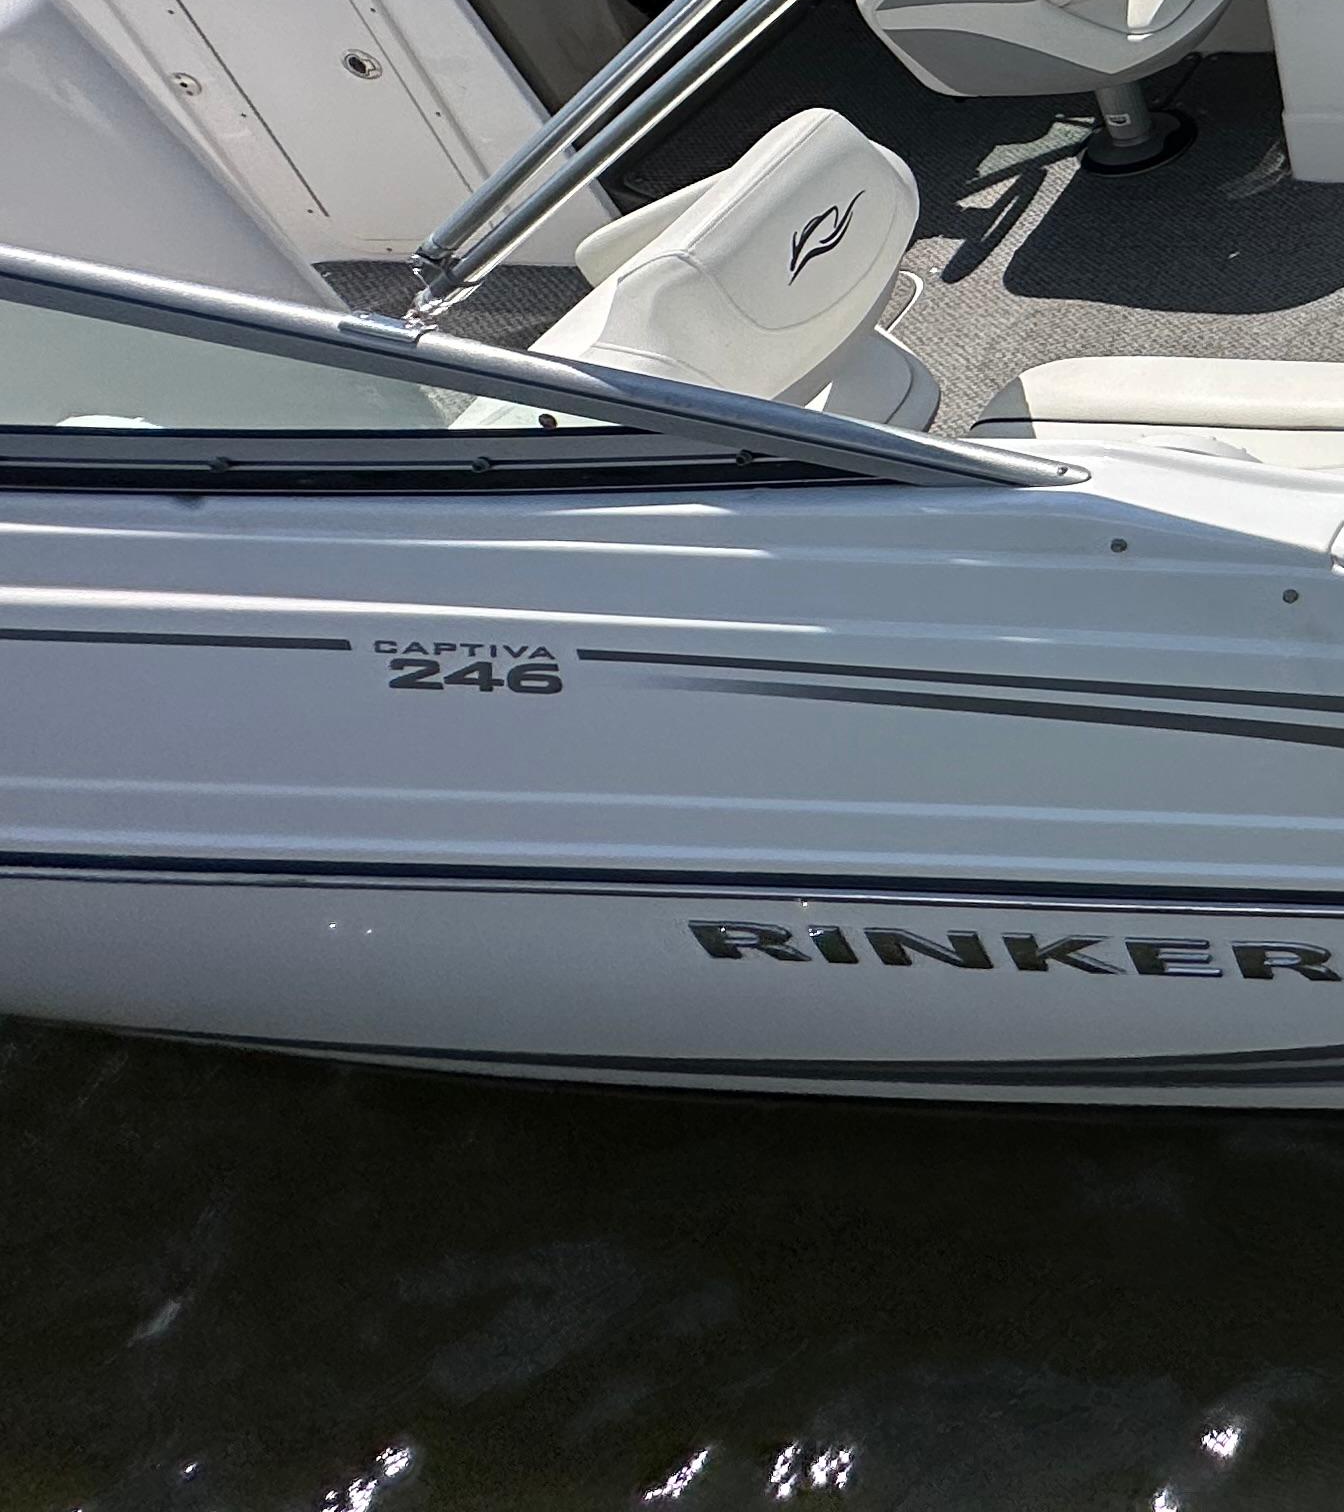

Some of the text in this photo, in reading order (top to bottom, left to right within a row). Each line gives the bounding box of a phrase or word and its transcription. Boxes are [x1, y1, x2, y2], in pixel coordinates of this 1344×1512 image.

[374, 640, 556, 660] CAPTIVA
[388, 657, 563, 694] 246
[687, 919, 1344, 982] RINKER
